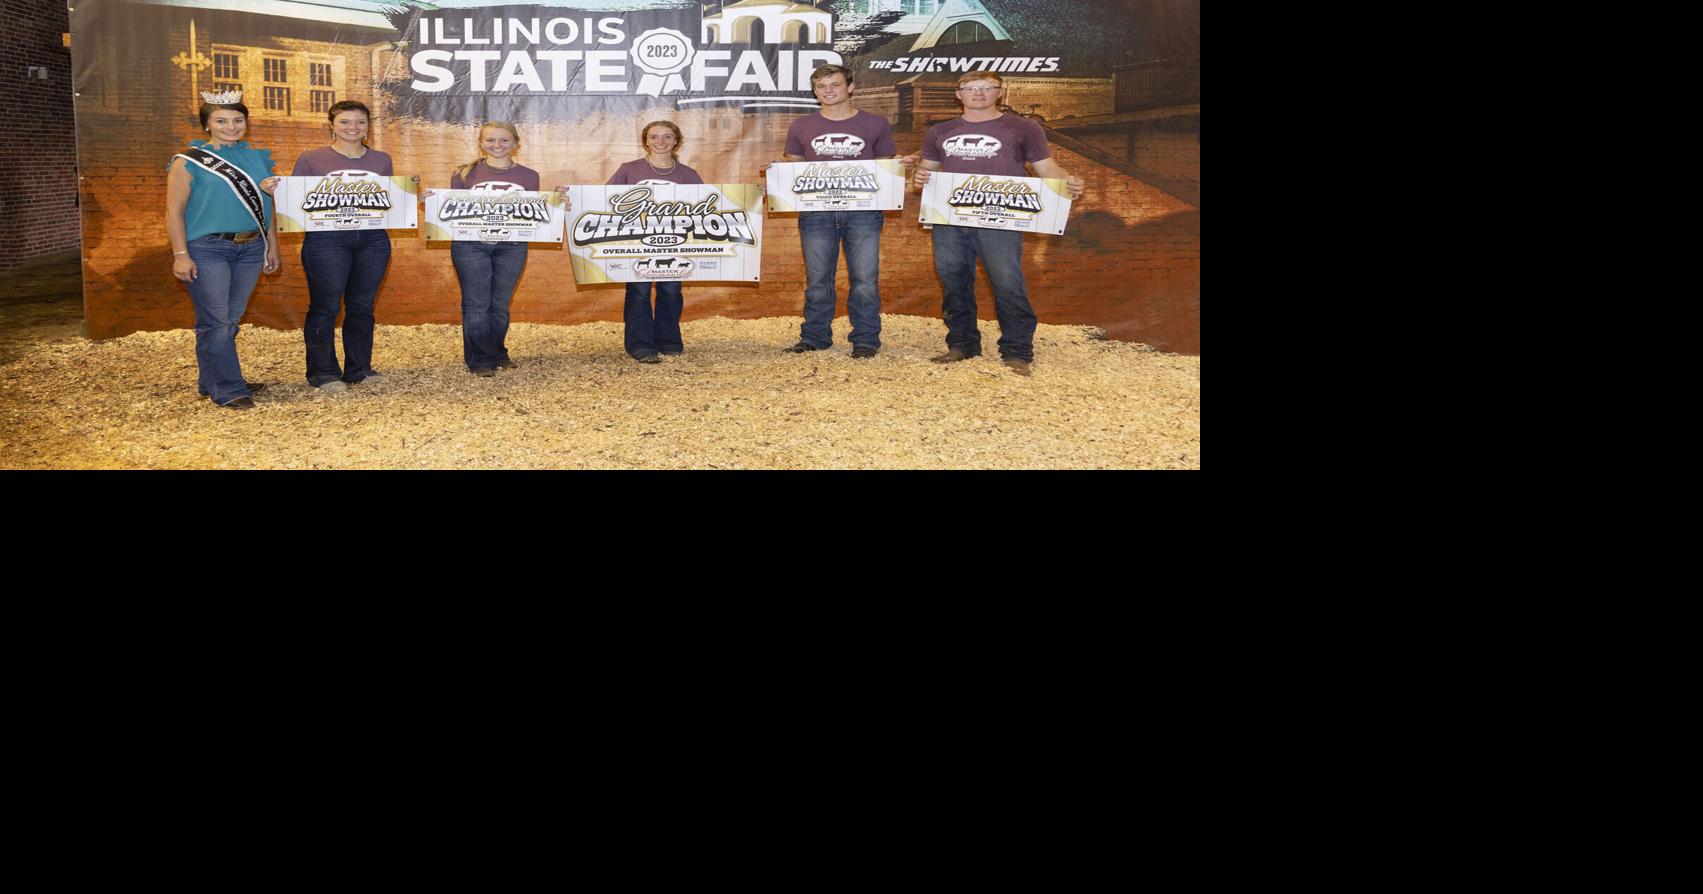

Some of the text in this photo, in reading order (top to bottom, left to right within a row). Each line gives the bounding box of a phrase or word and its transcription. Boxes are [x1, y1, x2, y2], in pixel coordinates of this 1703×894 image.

[419, 17, 625, 45] ILLINOIS
[646, 44, 678, 59] 2023
[410, 49, 628, 93] STATE
[869, 60, 893, 69] THE
[804, 163, 865, 178] Master
[316, 177, 380, 194] Master
[792, 174, 879, 194] SHOWMAN
[962, 176, 1029, 194] Master
[302, 191, 391, 212] SHOWMAN
[610, 187, 719, 223] Grand
[948, 188, 1042, 213] SHOWMAN
[439, 199, 551, 224] CHAMPION
[573, 210, 756, 246] CHAMPION
[649, 236, 679, 244] 2023
